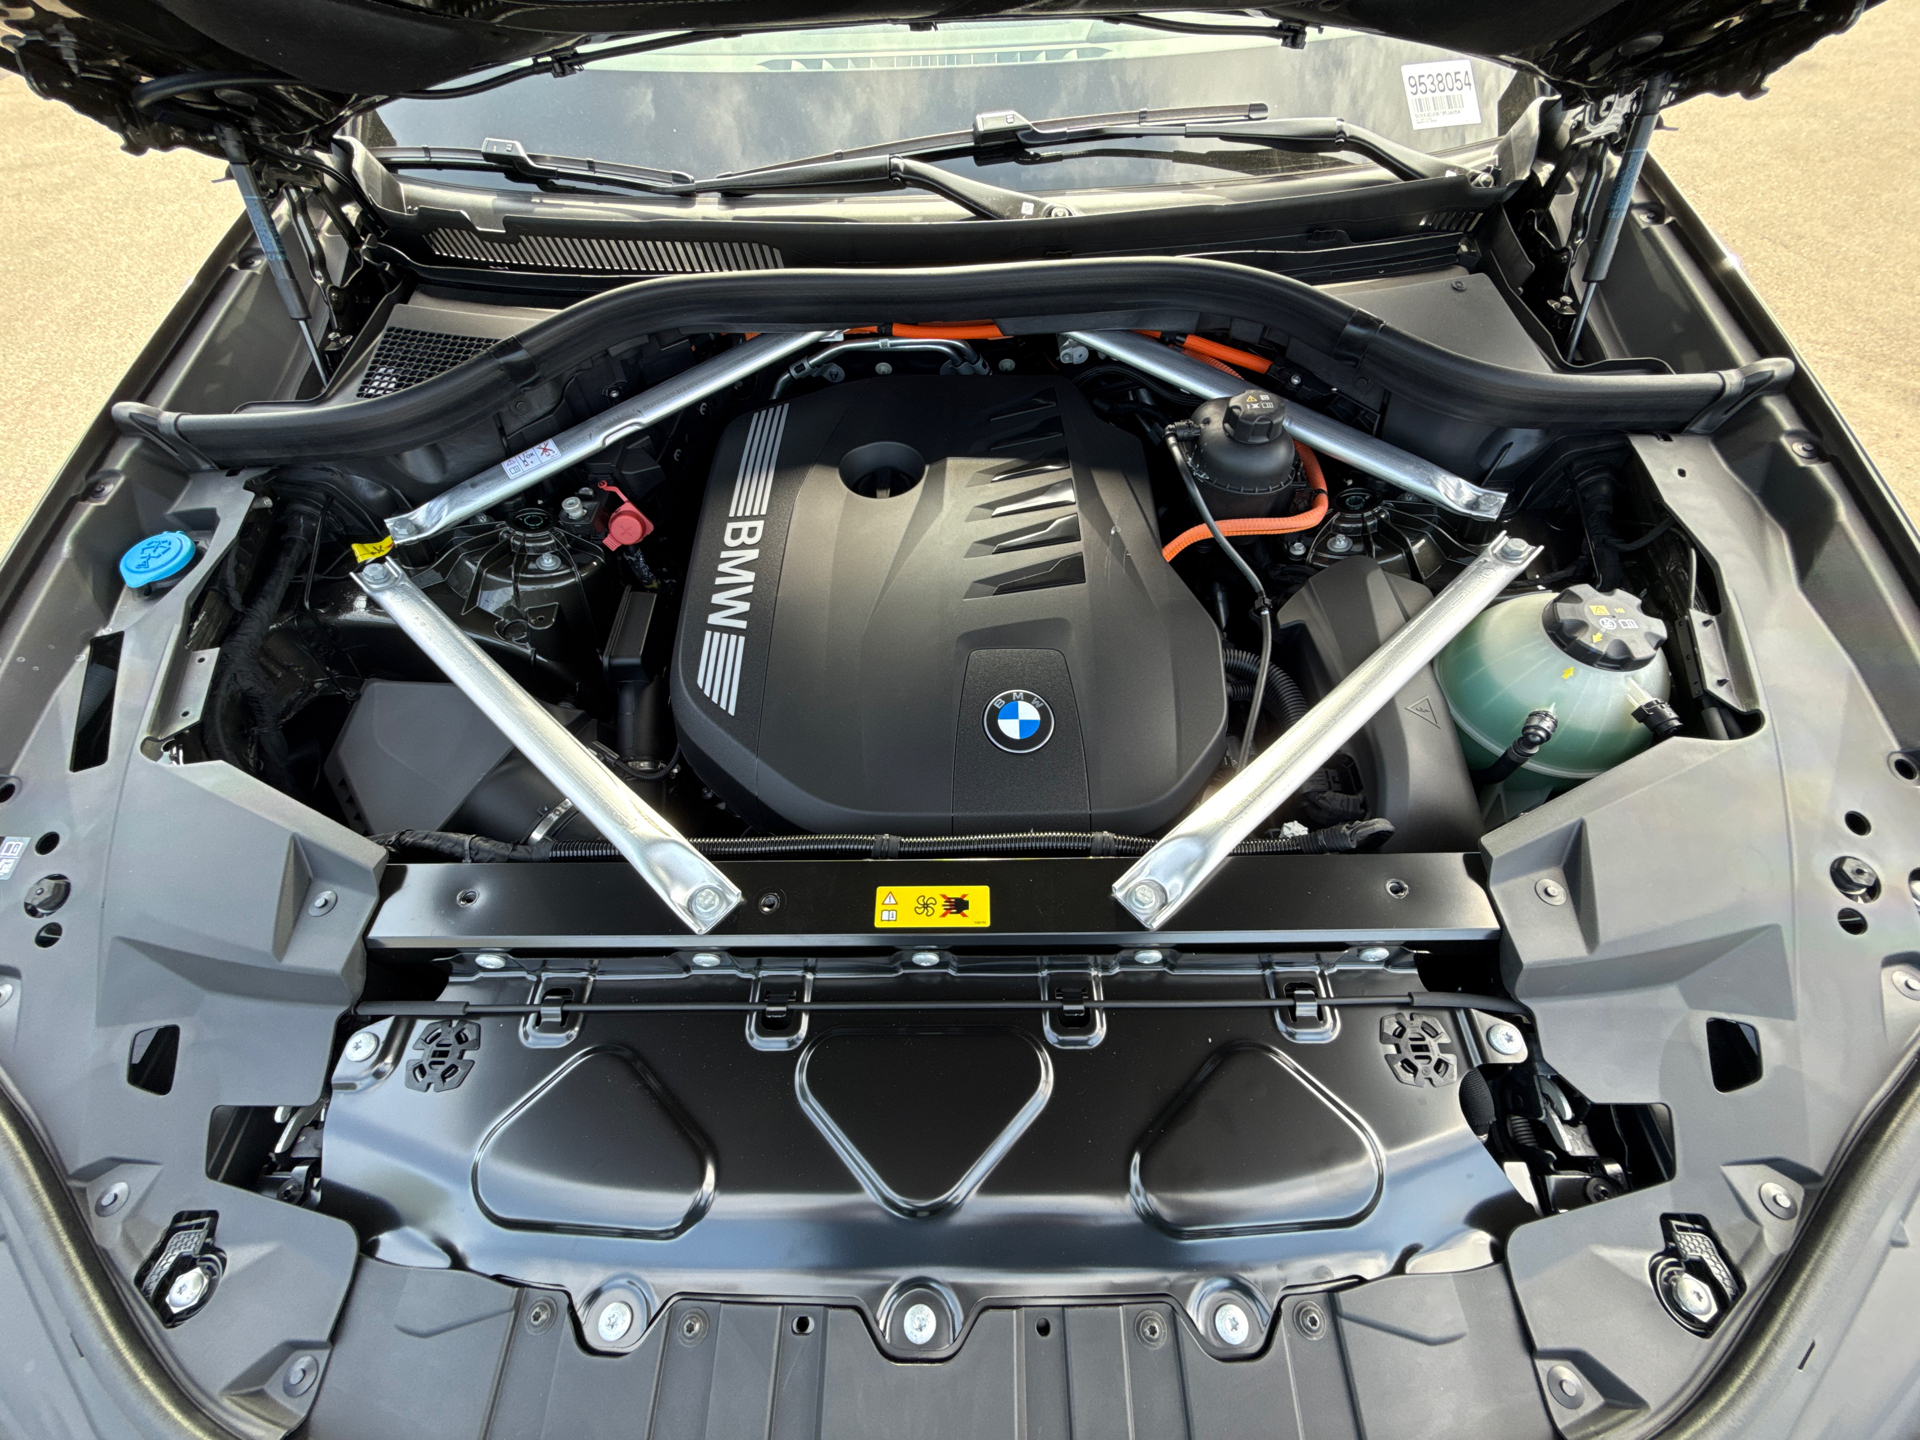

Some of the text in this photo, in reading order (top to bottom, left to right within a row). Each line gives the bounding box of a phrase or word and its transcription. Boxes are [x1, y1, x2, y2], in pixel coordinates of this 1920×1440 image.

[1408, 70, 1472, 95] 9538054
[706, 520, 765, 630] BMW
[993, 692, 1044, 709] BMW
